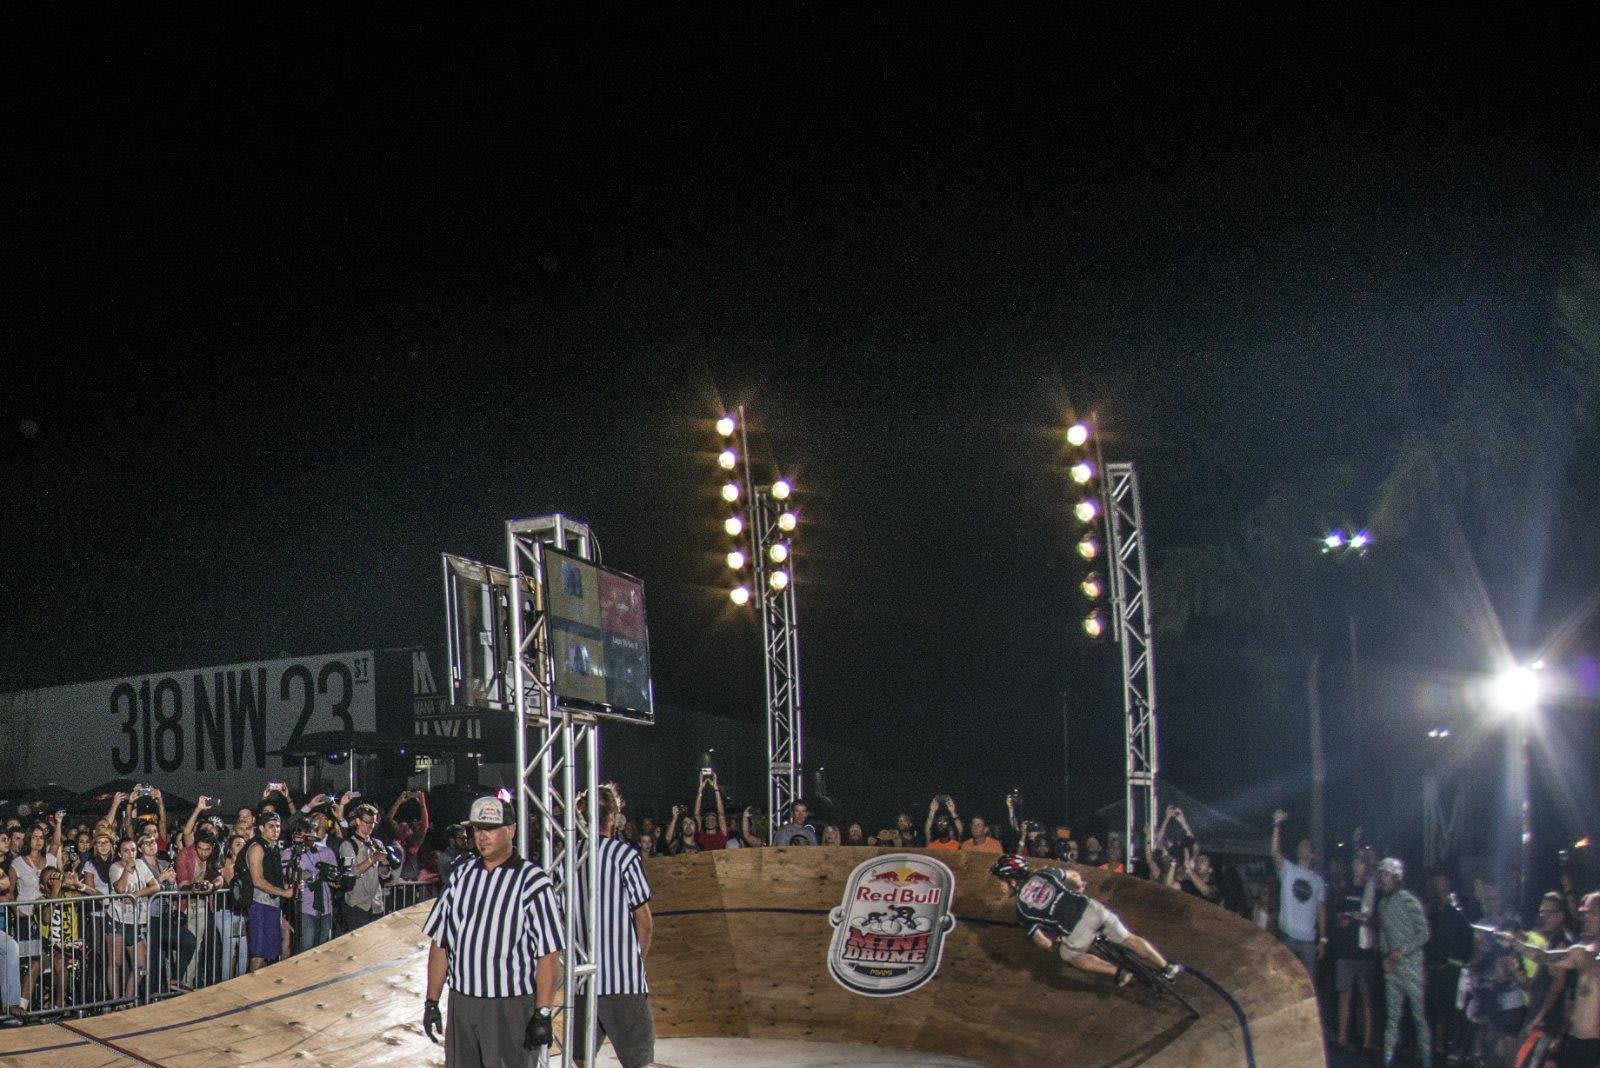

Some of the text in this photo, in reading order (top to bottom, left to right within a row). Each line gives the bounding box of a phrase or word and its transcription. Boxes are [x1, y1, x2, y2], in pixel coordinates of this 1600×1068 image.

[110, 677, 185, 774] 318
[193, 667, 267, 772] NW
[280, 660, 355, 768] 23
[354, 658, 369, 682] ST
[856, 886, 940, 904] Red Bull
[846, 926, 928, 950] MINI
[843, 945, 926, 963] DROME
